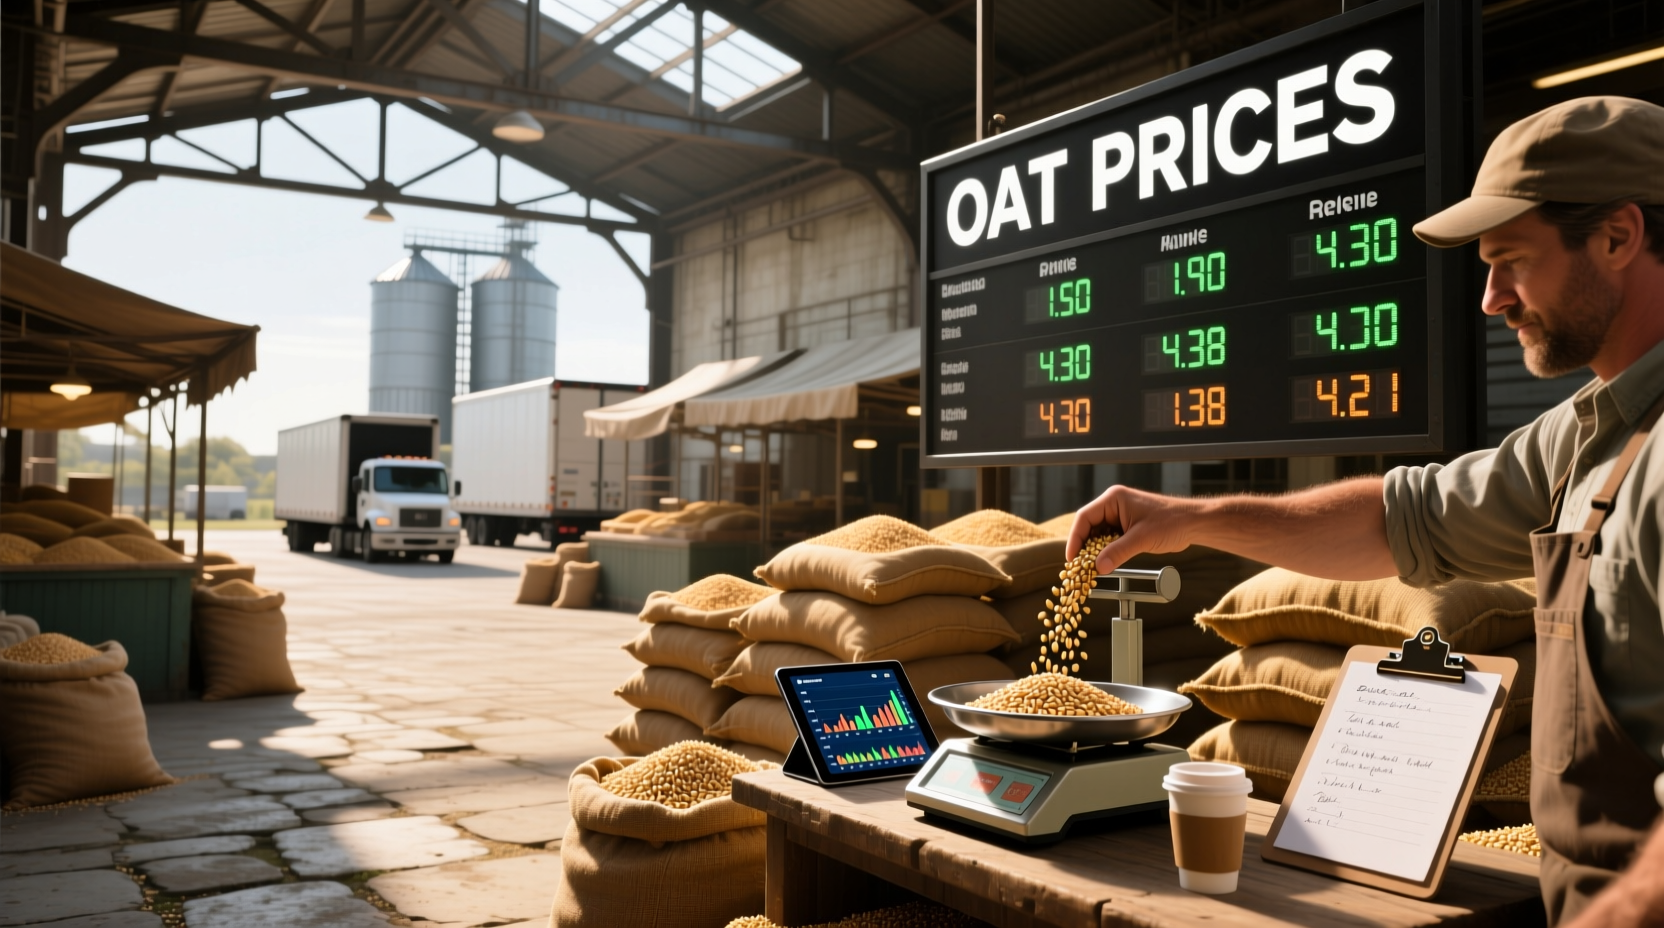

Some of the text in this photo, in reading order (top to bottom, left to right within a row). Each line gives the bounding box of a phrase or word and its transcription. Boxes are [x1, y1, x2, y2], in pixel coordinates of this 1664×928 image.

[946, 49, 1396, 247] OAT PRICES
[1049, 217, 1398, 317] 1.50 1.90 4.30
[1040, 344, 1091, 382] 4.30
[1162, 326, 1226, 368] 4.38
[1174, 386, 1226, 427] 1.38
[1316, 372, 1399, 418] 4.21
